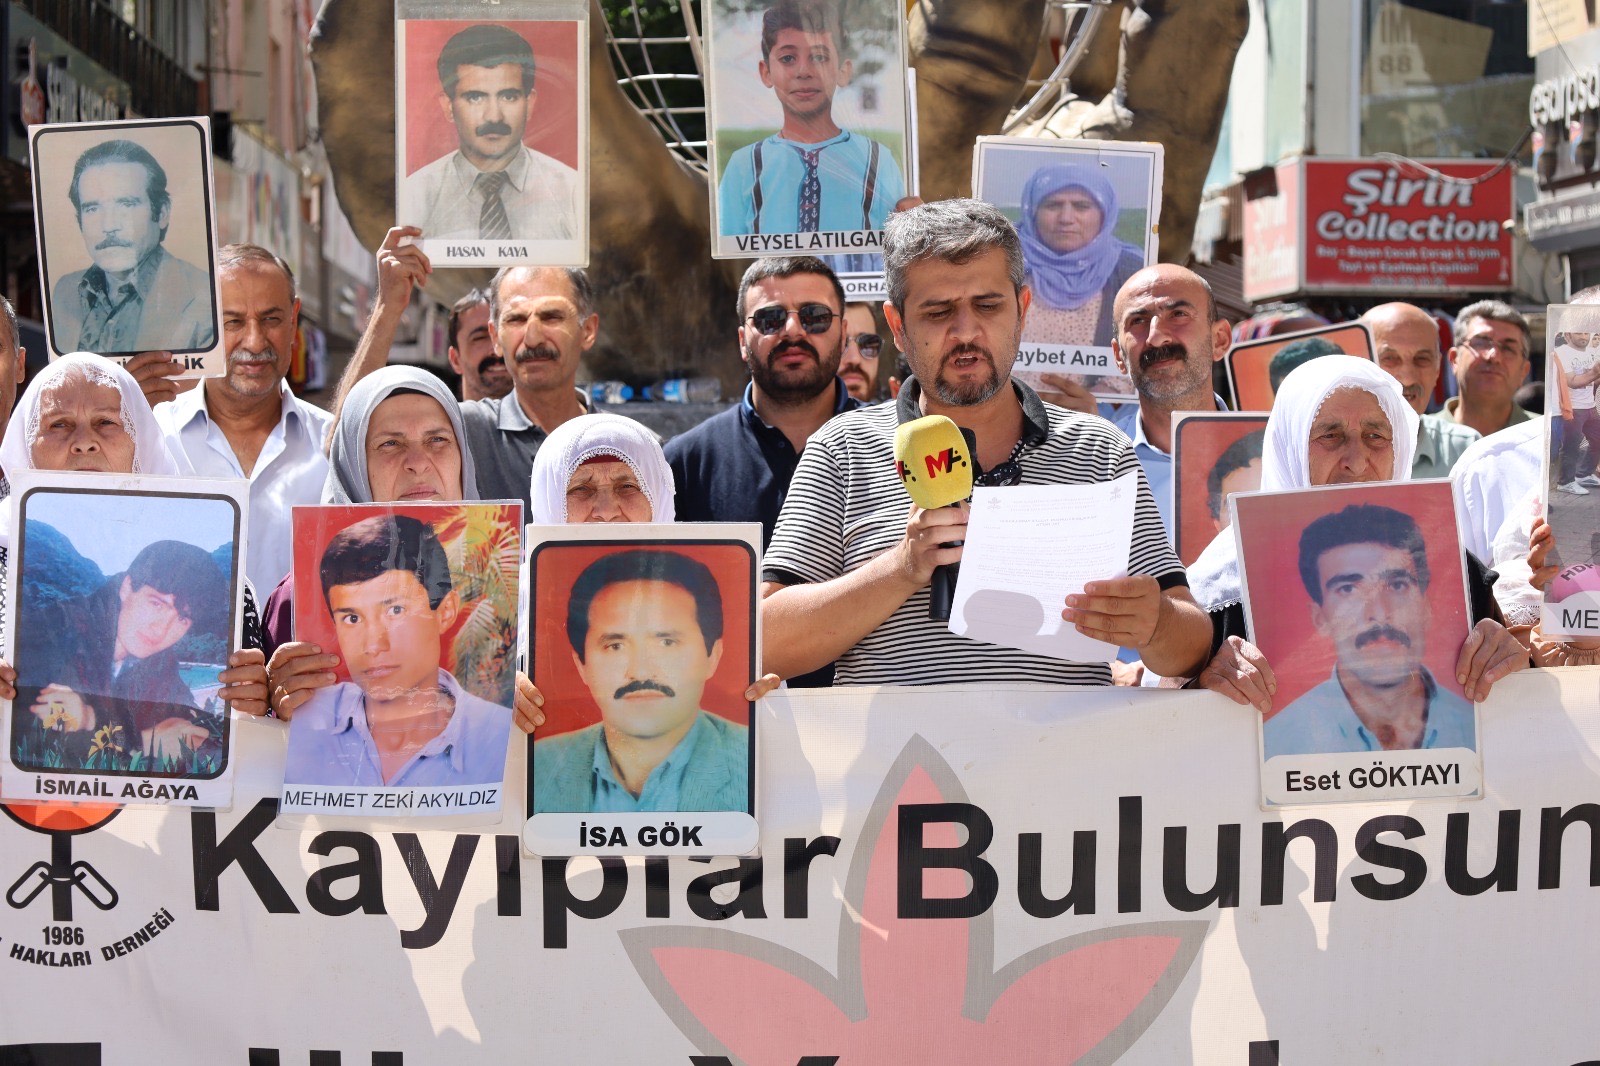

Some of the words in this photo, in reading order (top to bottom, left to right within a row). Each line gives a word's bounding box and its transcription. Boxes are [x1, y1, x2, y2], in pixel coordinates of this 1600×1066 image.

[1344, 168, 1473, 216] Şirin
[1316, 211, 1499, 241] Collection
[447, 246, 485, 257] HASAN
[498, 246, 528, 257] KAYA
[736, 234, 803, 250] VEYSEL
[1015, 348, 1066, 366] aybet
[1070, 350, 1108, 366] Ana
[35, 776, 113, 797] İSMAİL
[121, 780, 199, 801] AĞAYA
[1286, 770, 1341, 792] Eset
[1349, 761, 1460, 789] GÖKTAYI
[284, 791, 368, 808] MEHMET
[372, 790, 414, 809] ZEKİ
[417, 789, 497, 808] AKYILDIZ
[580, 822, 628, 847] İSA
[637, 822, 703, 847] GÖK
[897, 796, 1600, 919] Bulunsun
[9, 943, 92, 968] HAKLARI
[100, 907, 175, 962] DERNEĞİ
[42, 926, 85, 946] 1986
